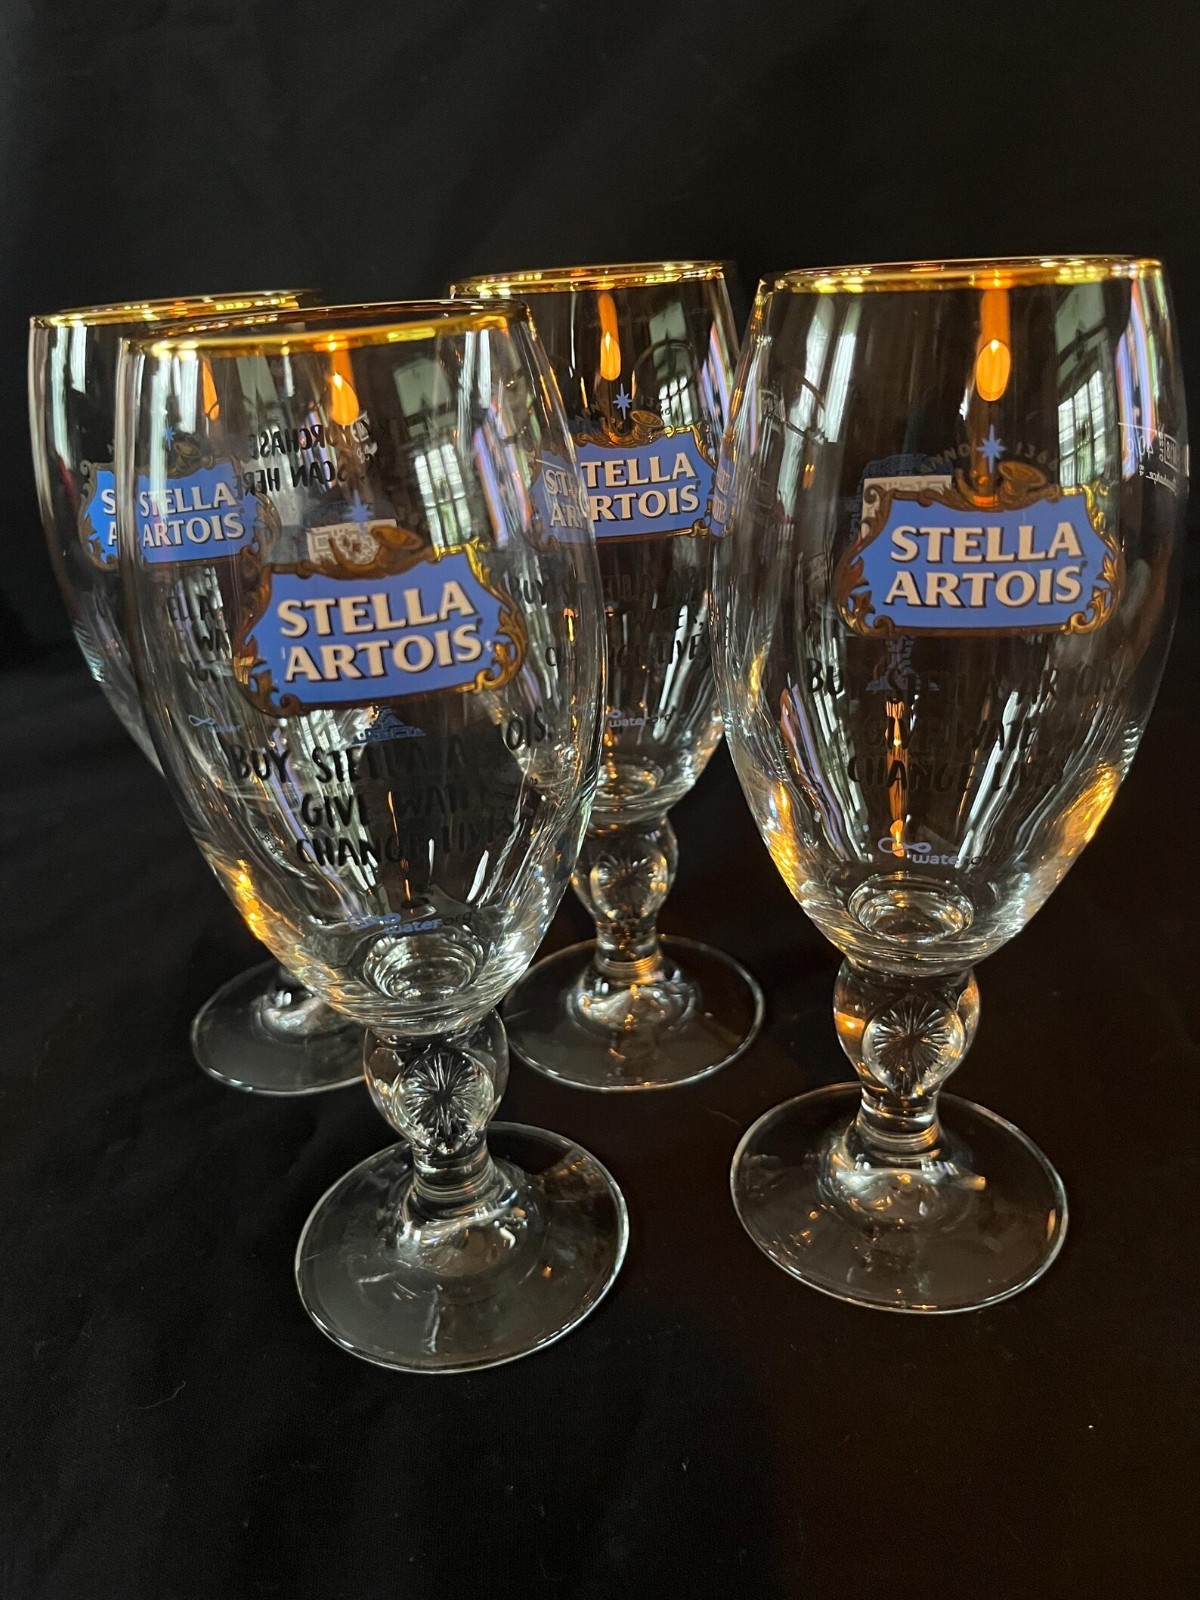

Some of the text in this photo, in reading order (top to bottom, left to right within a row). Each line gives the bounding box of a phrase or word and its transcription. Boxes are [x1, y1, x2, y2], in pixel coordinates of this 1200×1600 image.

[580, 452, 698, 489] TELLA
[139, 482, 238, 518] STELLA
[590, 484, 700, 521] RTOIS
[142, 512, 246, 549] ARTOIS
[890, 521, 1085, 564] STELLA
[884, 565, 1084, 609] ARTOIS
[277, 580, 476, 639] STELLA
[285, 623, 484, 683] ARTOIS
[230, 743, 291, 783] BUY
